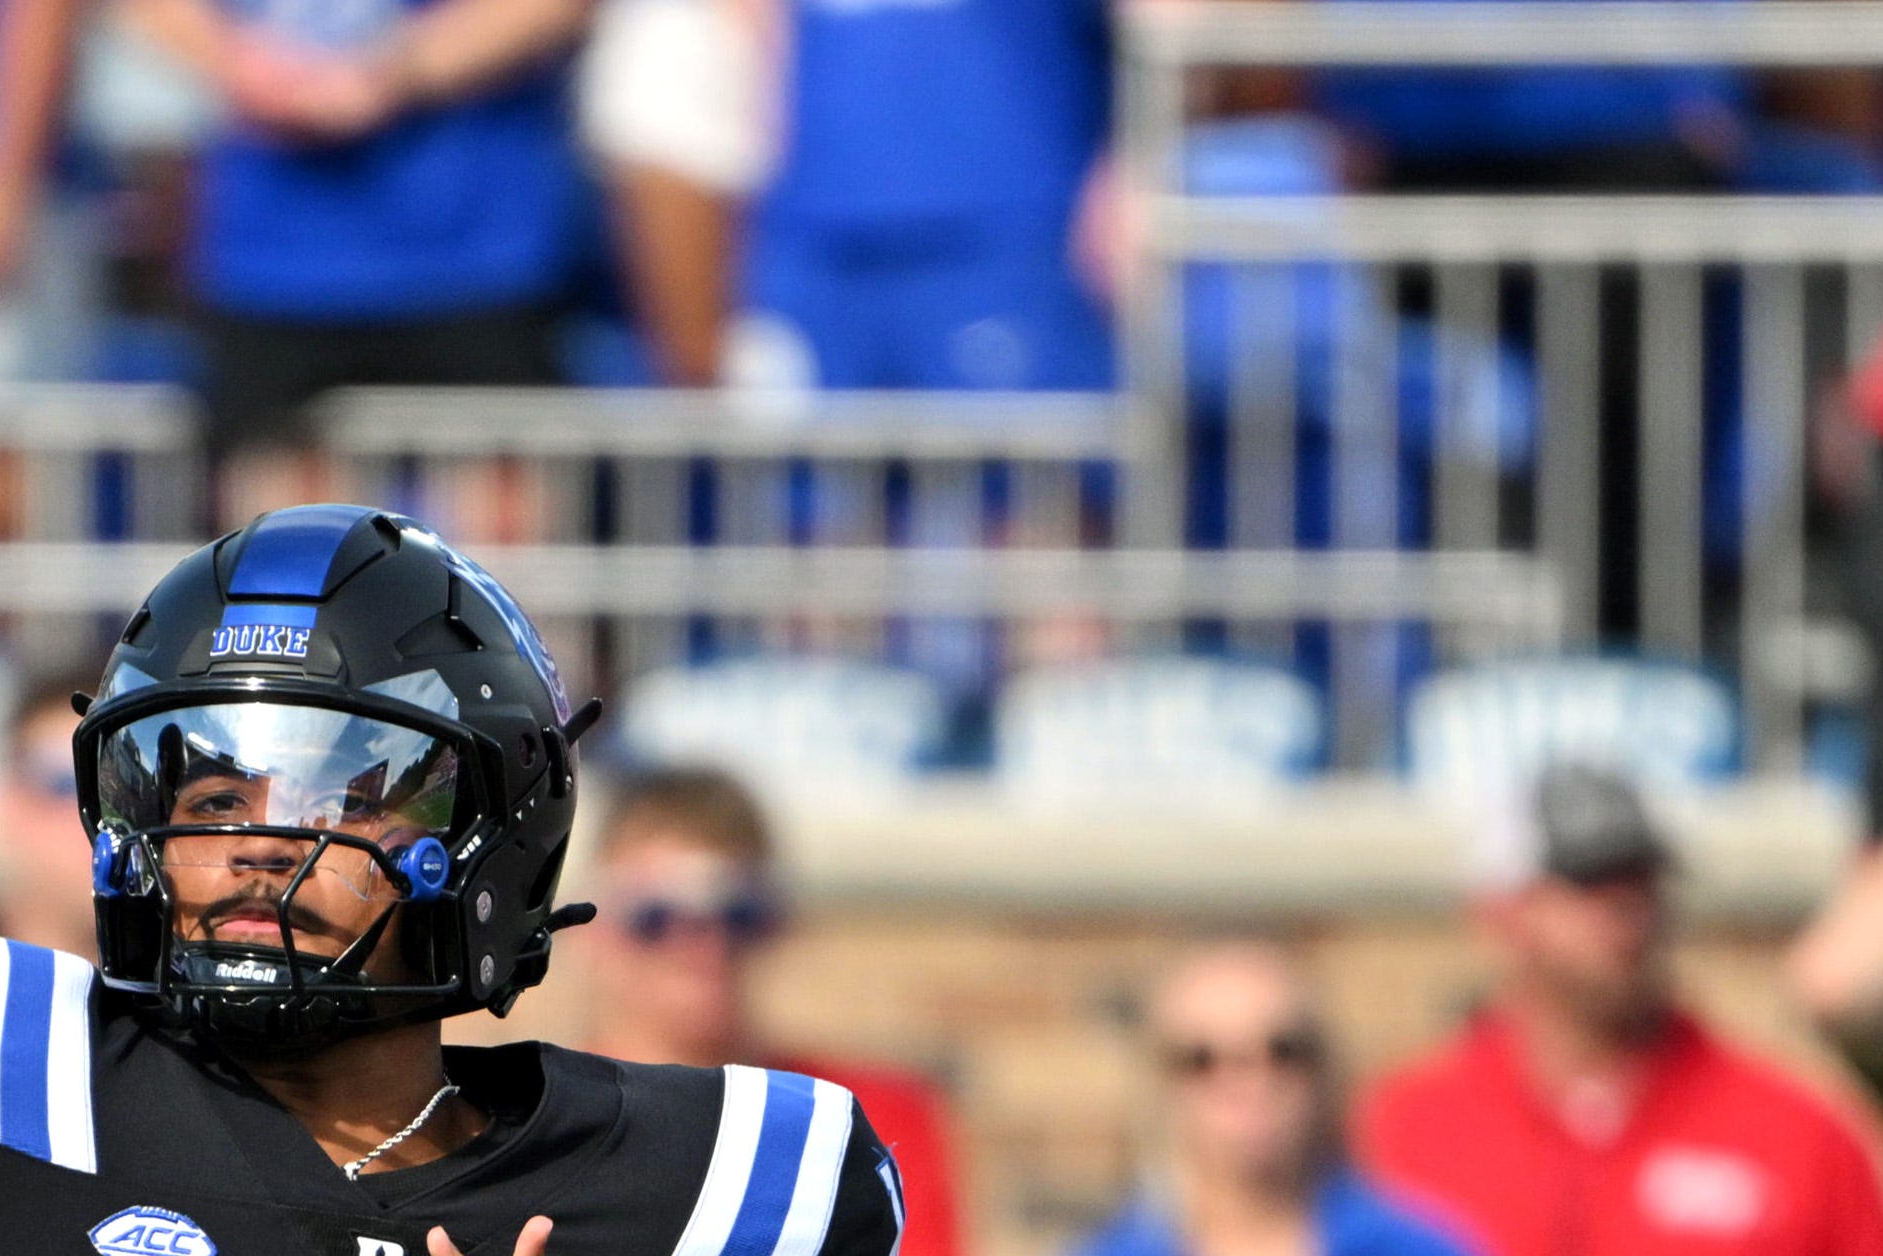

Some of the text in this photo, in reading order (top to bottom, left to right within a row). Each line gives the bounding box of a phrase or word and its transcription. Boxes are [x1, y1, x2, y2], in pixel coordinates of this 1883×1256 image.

[210, 625, 310, 657] DUKE
[215, 961, 277, 983] Riddell
[109, 1225, 200, 1255] ACC
